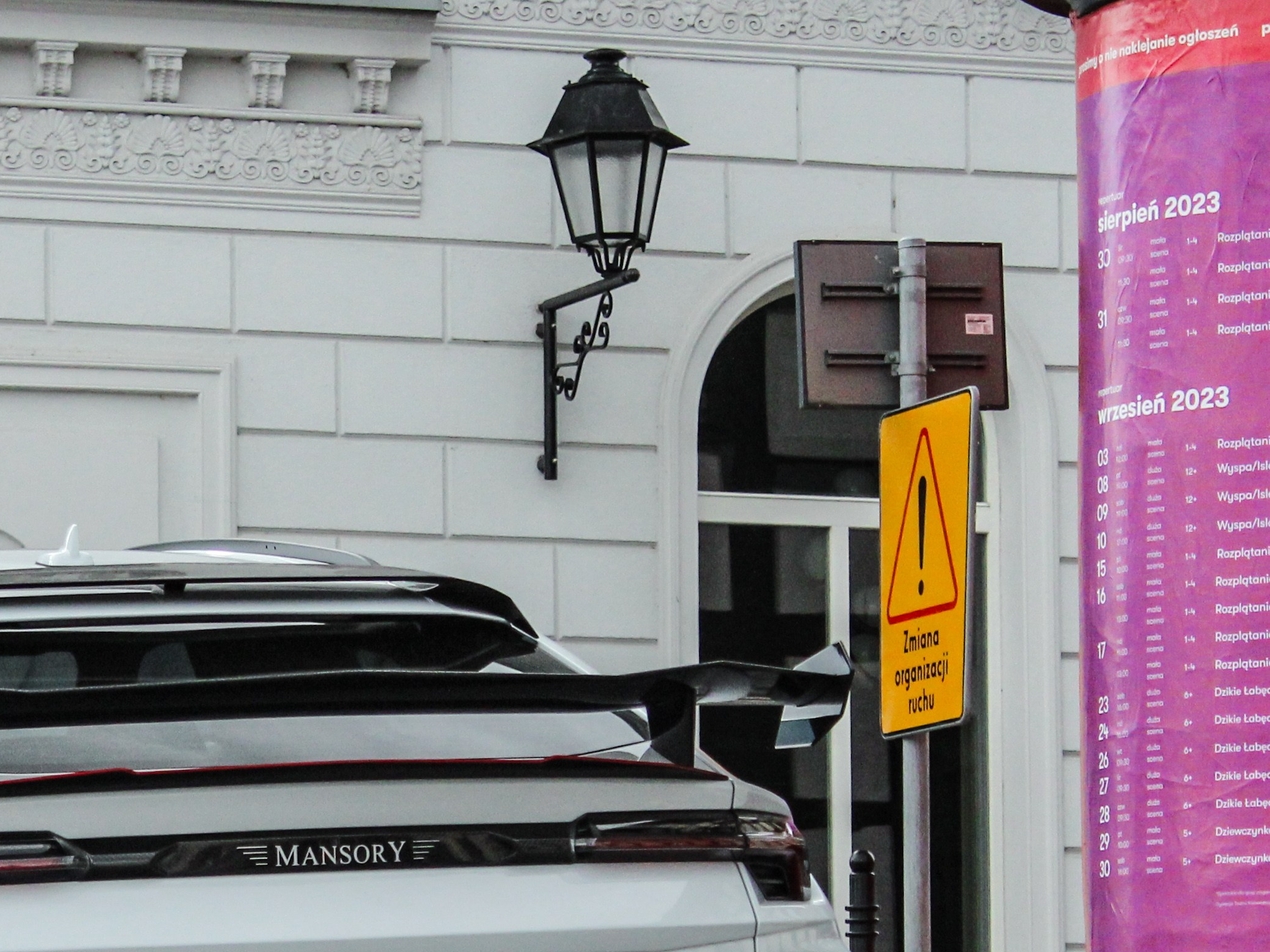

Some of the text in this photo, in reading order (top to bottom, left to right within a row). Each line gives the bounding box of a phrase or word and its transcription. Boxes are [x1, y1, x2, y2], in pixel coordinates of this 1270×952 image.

[1099, 55, 1104, 63] o
[1105, 47, 1117, 61] nie
[1119, 34, 1176, 57] naklejanie
[1179, 24, 1239, 47] ogłoszeń
[1098, 191, 1221, 233] sierpień 2023
[1098, 249, 1111, 269] 30
[1150, 250, 1169, 258] scena
[1150, 279, 1169, 288] scena
[1098, 309, 1108, 329] 31
[1150, 310, 1169, 318] scena
[1150, 341, 1169, 349] scena
[1098, 386, 1230, 425] wrzesień 2023
[1098, 448, 1109, 466] 03
[1097, 476, 1109, 494] 08
[1097, 503, 1109, 521] 09
[1097, 532, 1107, 549] 10
[1097, 560, 1107, 577] 15
[1147, 562, 1165, 570] scena
[1097, 587, 1107, 604] 16
[904, 627, 939, 653] Zmiana
[1097, 641, 1106, 659] 17
[895, 652, 949, 691] organizacji
[1184, 691, 1193, 699] 6+
[1215, 687, 1242, 697] Dzikie
[909, 688, 935, 714] ruchu
[1099, 696, 1109, 714] 23
[1184, 719, 1193, 727] 6+
[1215, 715, 1242, 725] Dzikie
[1099, 723, 1109, 740] 24
[1215, 744, 1242, 754] Dzikie
[1099, 752, 1109, 769] 26
[1215, 772, 1242, 781] Dzikie
[1099, 777, 1110, 795] 27
[1216, 799, 1243, 809] Dzikie
[1100, 805, 1110, 823] 28
[1100, 833, 1110, 850] 29
[1183, 830, 1192, 838] 5+
[274, 841, 407, 867] MANSORY
[1183, 858, 1192, 866] 5+
[1100, 860, 1111, 878] 30
